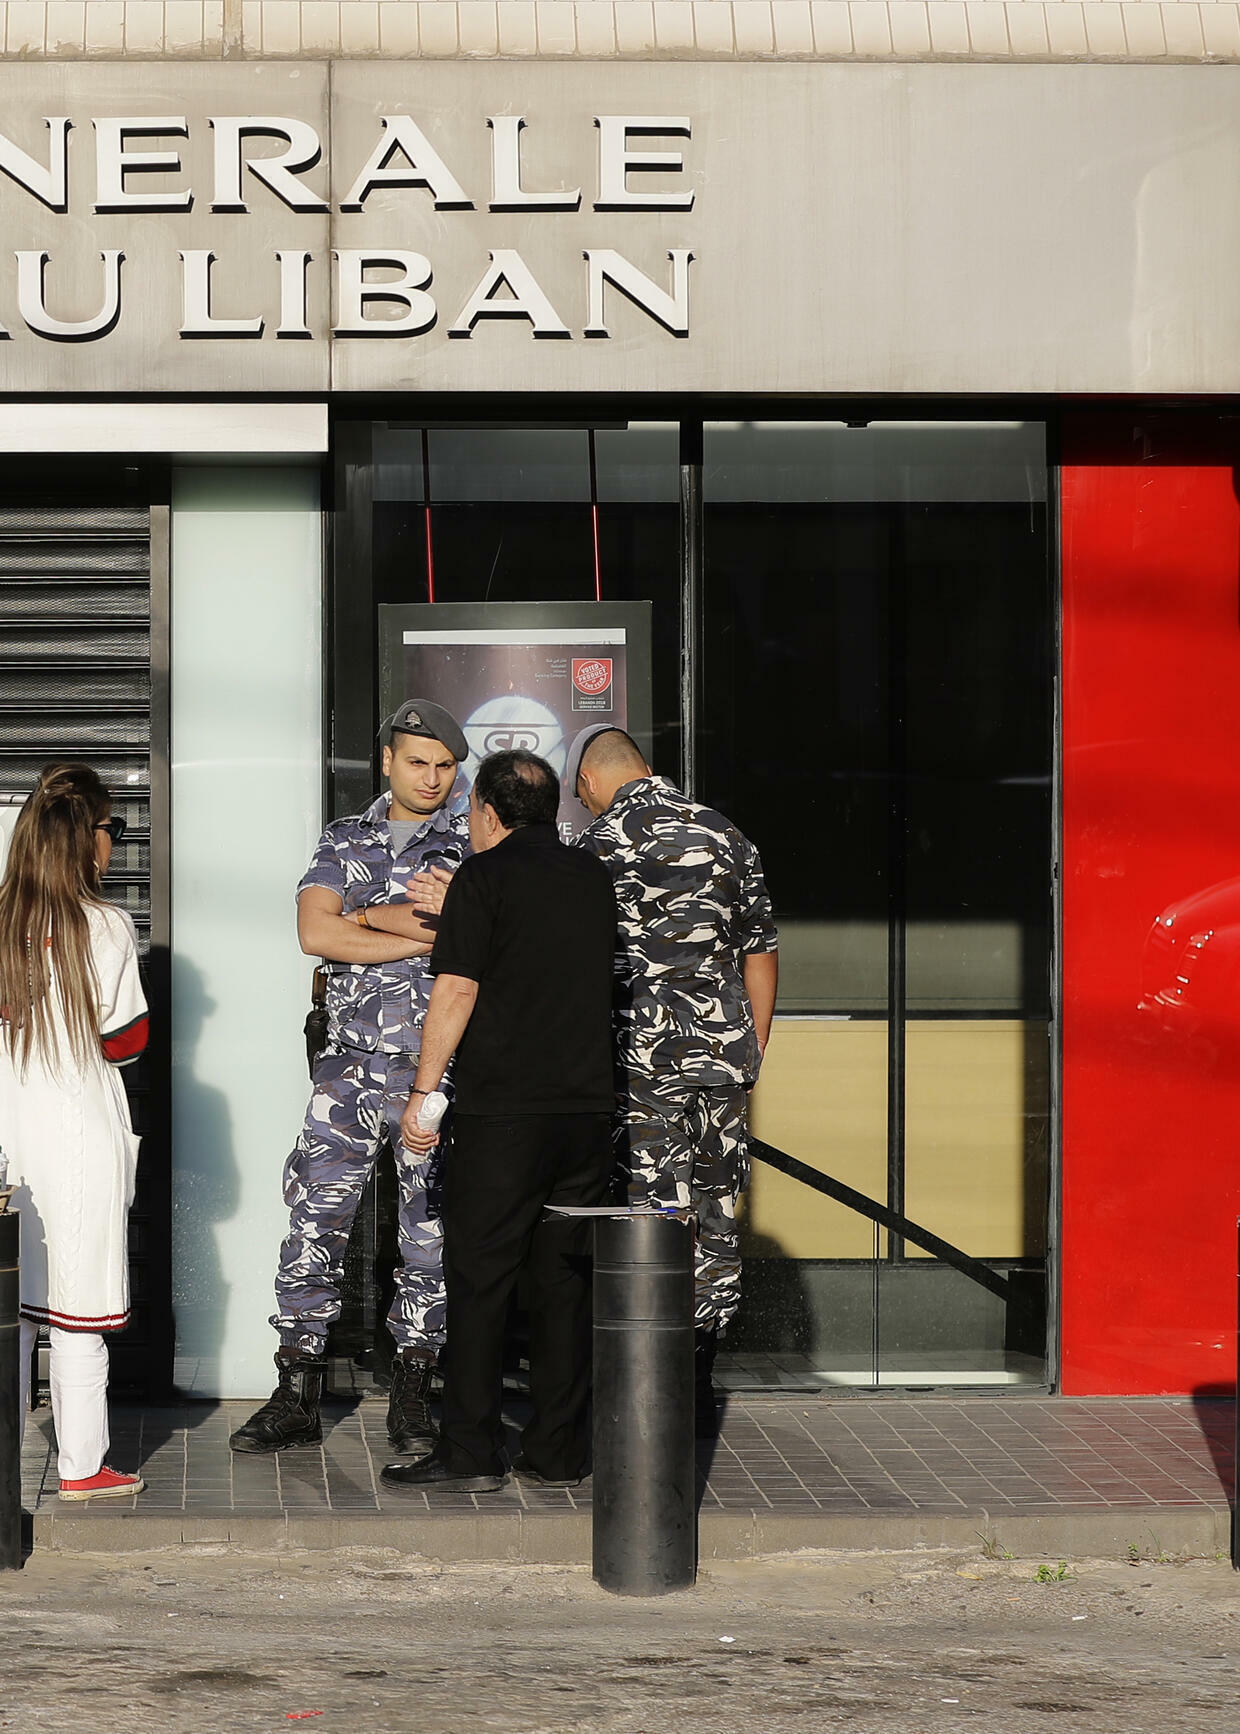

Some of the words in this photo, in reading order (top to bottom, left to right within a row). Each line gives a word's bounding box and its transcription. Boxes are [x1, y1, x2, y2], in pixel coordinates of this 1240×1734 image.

[176, 248, 697, 340] LIBAN
[578, 668, 606, 682] PRODUCT
[581, 663, 599, 674] VOTED
